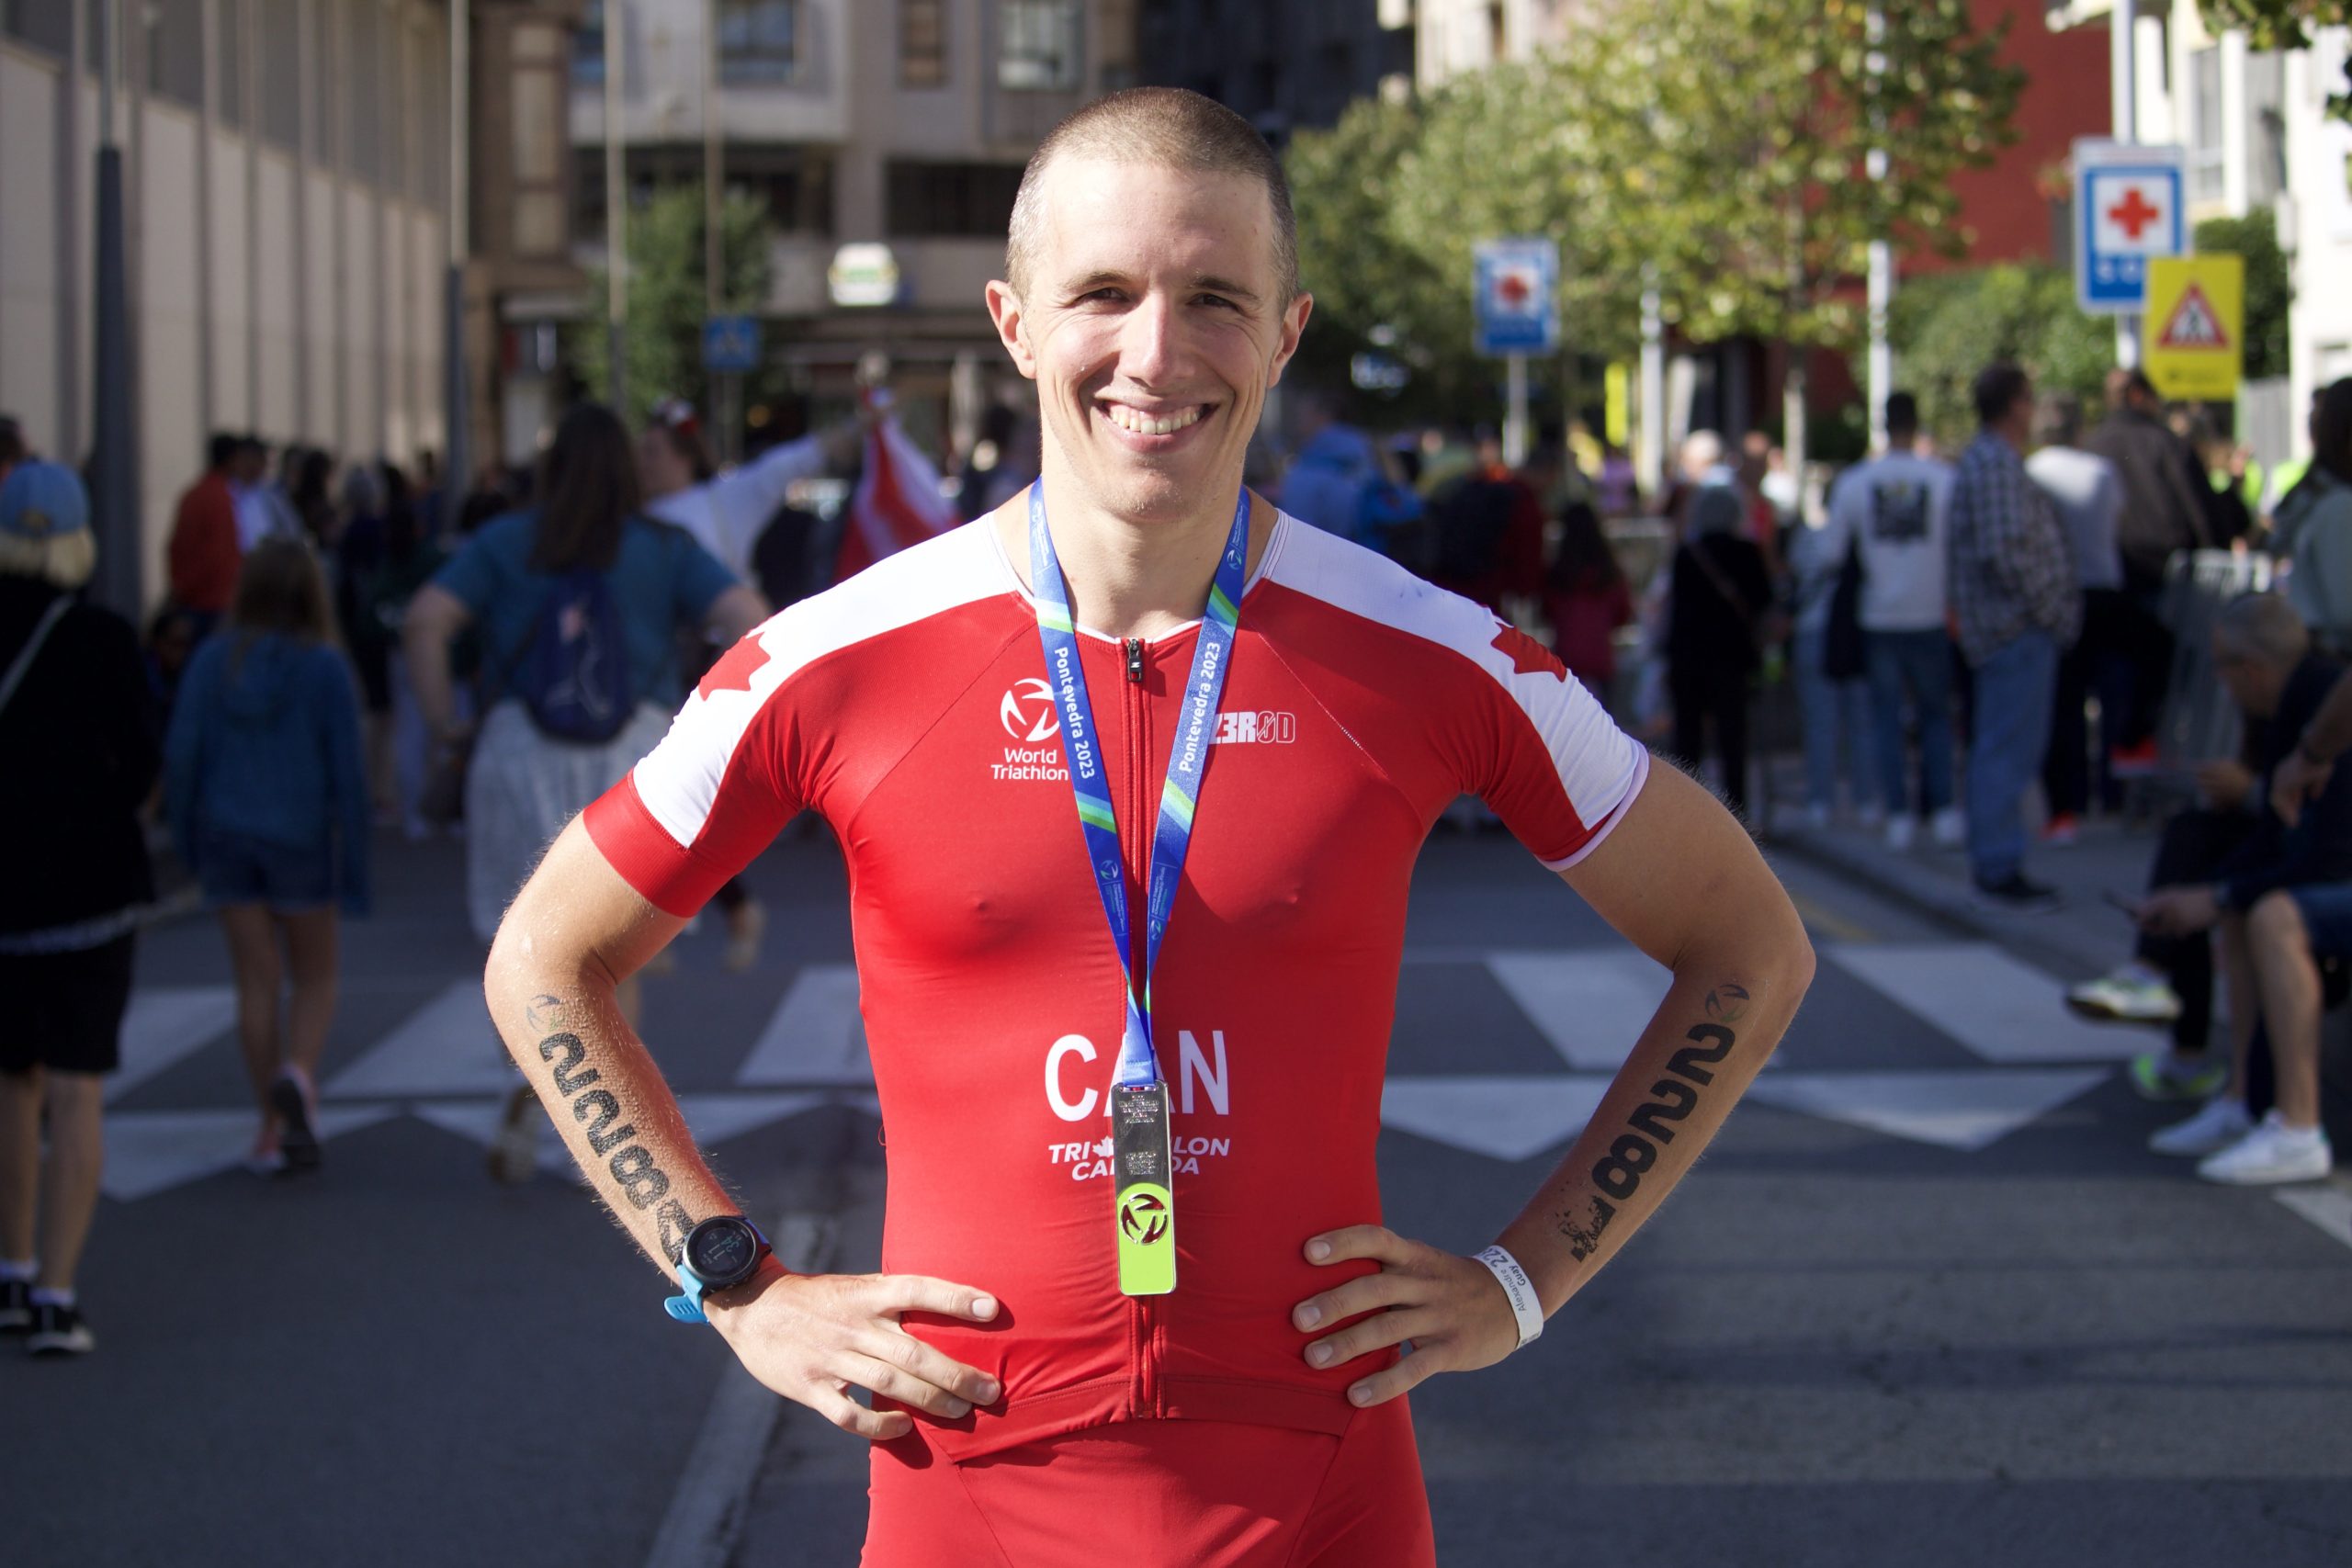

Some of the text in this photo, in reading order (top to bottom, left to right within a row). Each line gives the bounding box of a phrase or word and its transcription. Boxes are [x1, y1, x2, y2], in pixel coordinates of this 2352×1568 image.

[1054, 646, 1095, 779] Pontevedra 2023
[1179, 641, 1221, 773] Pontevedra 2023
[1004, 747, 1057, 764] World
[990, 763, 1069, 781] Triathlon
[1500, 1269, 1527, 1312] Alexandre
[1509, 1265, 1526, 1286] Guay
